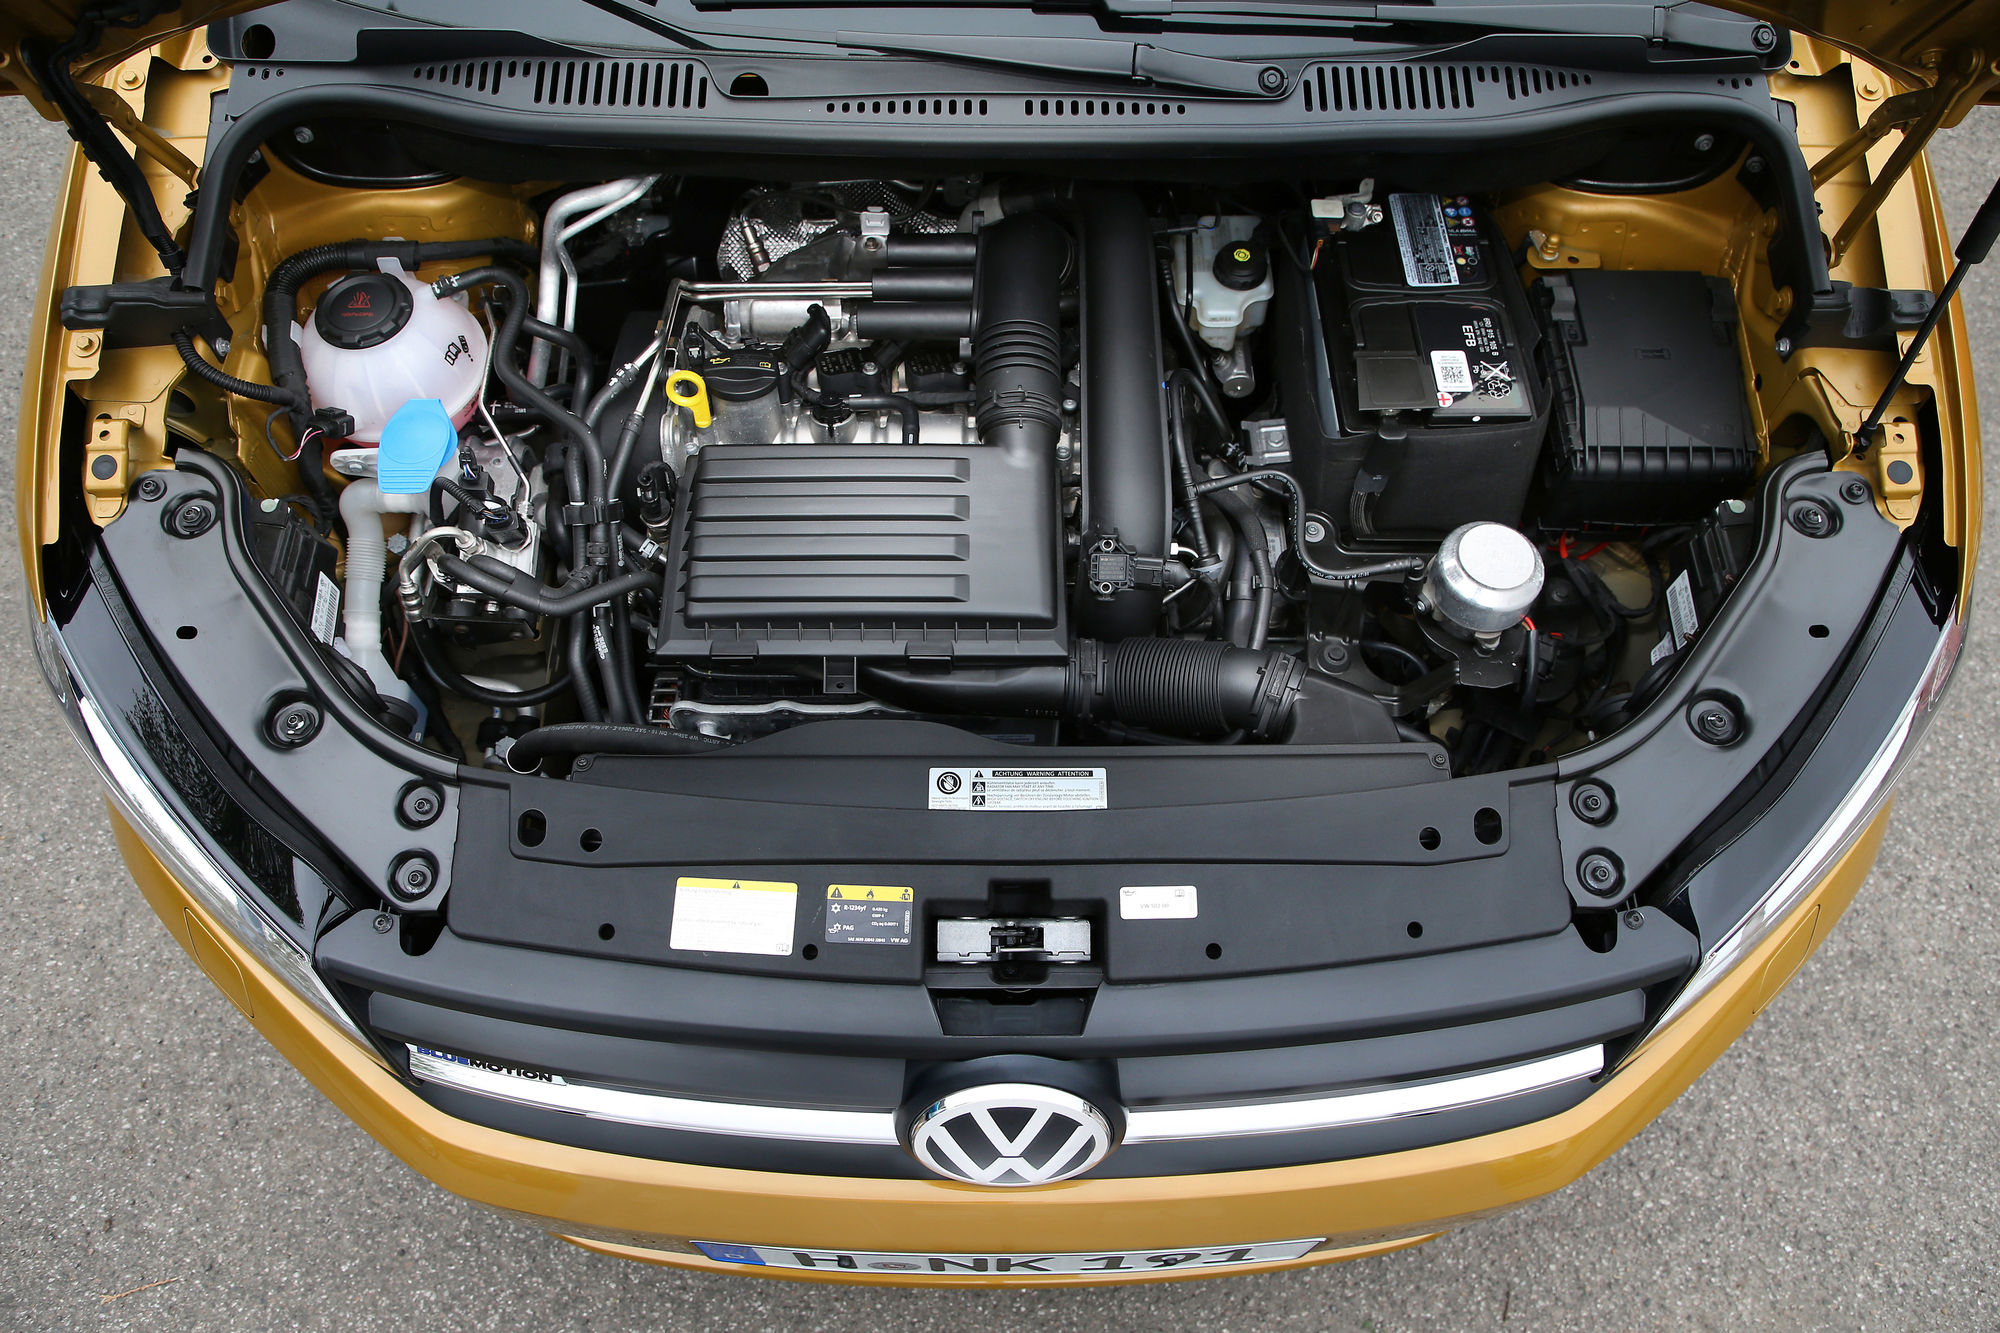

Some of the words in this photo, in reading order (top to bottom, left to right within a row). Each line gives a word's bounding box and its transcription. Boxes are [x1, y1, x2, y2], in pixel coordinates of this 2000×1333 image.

[1462, 325, 1476, 347] EFB
[1472, 365, 1480, 374] Pb
[416, 1046, 552, 1082] BLUEMOTION
[920, 1099, 1102, 1185] VW
[793, 1252, 858, 1269] H
[928, 1257, 1054, 1272] NK
[1080, 1248, 1255, 1270] 191
